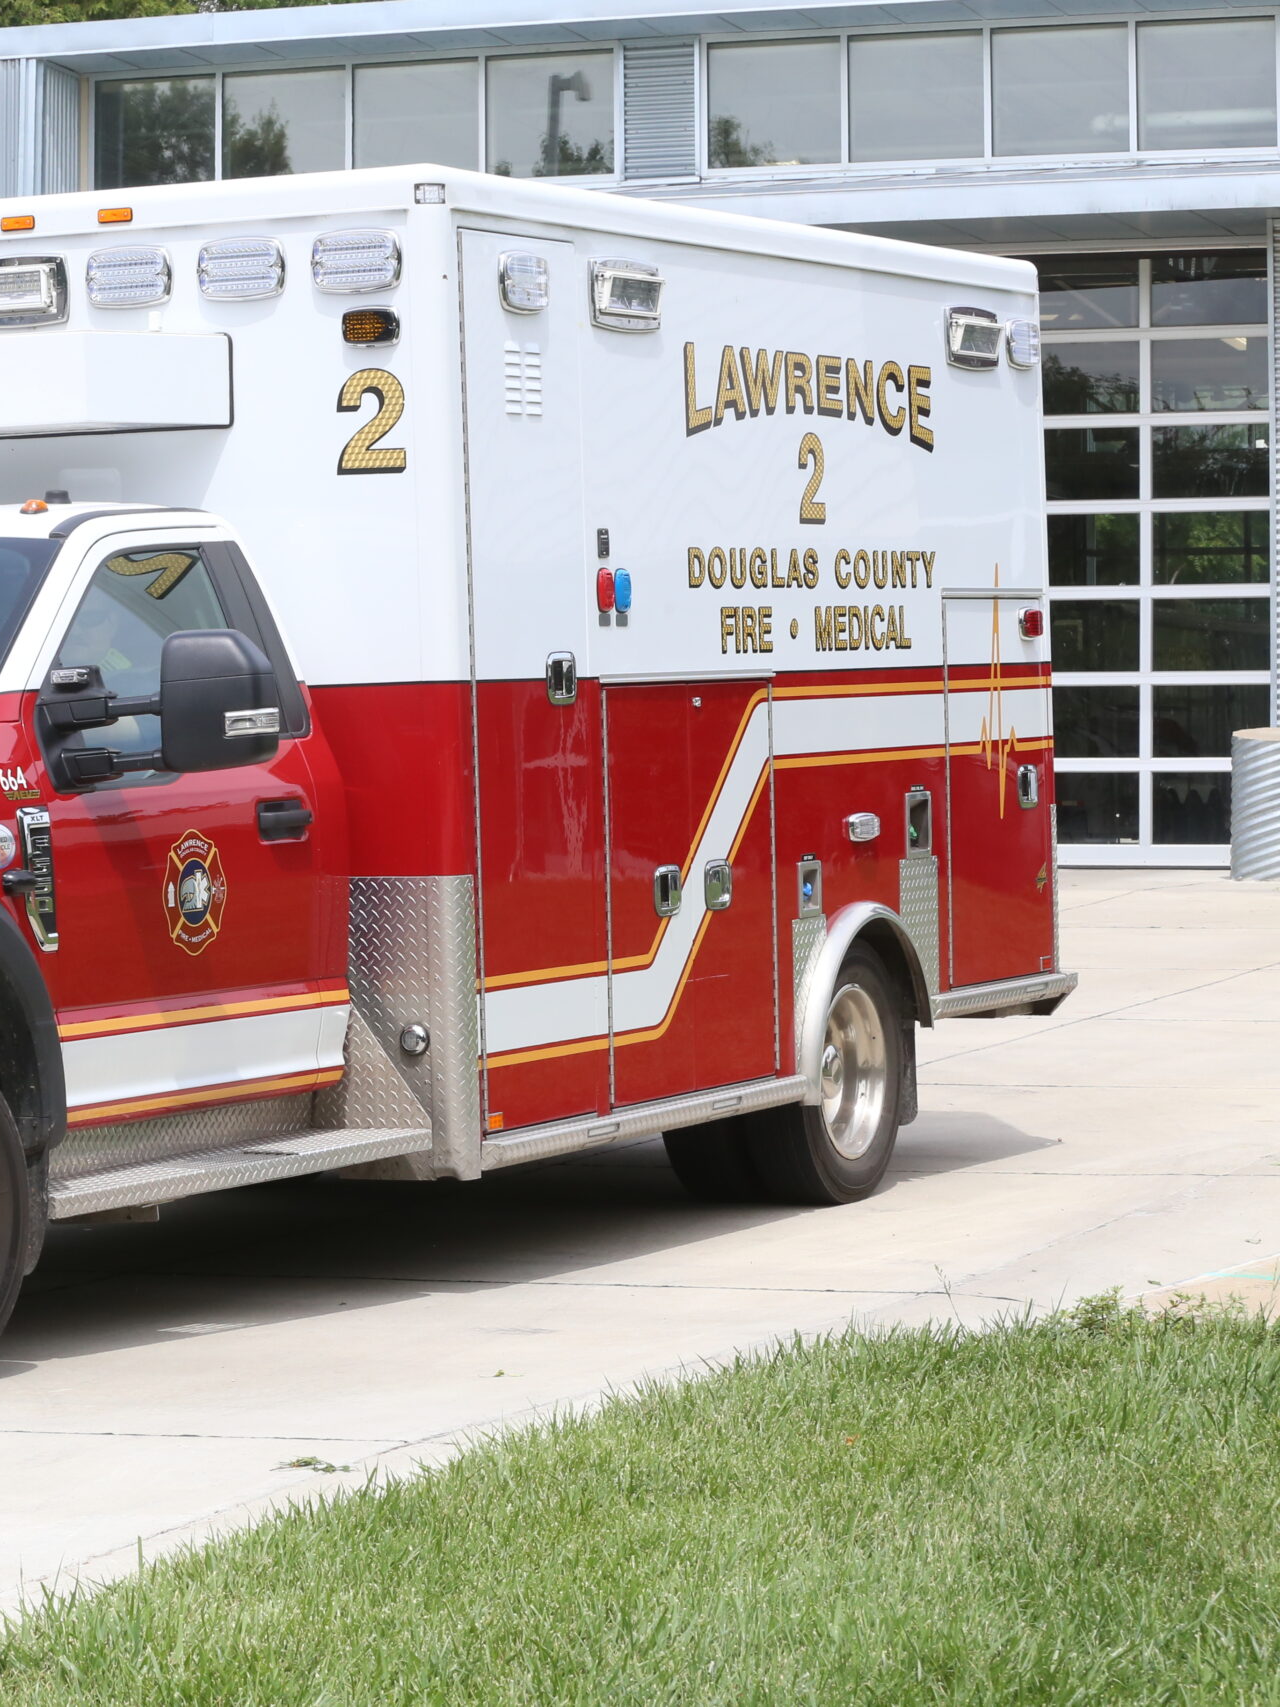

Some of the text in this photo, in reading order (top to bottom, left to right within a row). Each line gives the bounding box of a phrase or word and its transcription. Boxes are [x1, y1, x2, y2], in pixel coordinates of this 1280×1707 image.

[337, 368, 406, 475] 2
[683, 341, 934, 453] LAWRENCE
[798, 432, 826, 525] 2
[687, 547, 936, 589] DOUGLAS COUNTY
[720, 604, 913, 654] FIRE MEDICAL
[177, 839, 209, 855] LAWRENCE
[178, 928, 212, 943] FIRE MEDICAL
